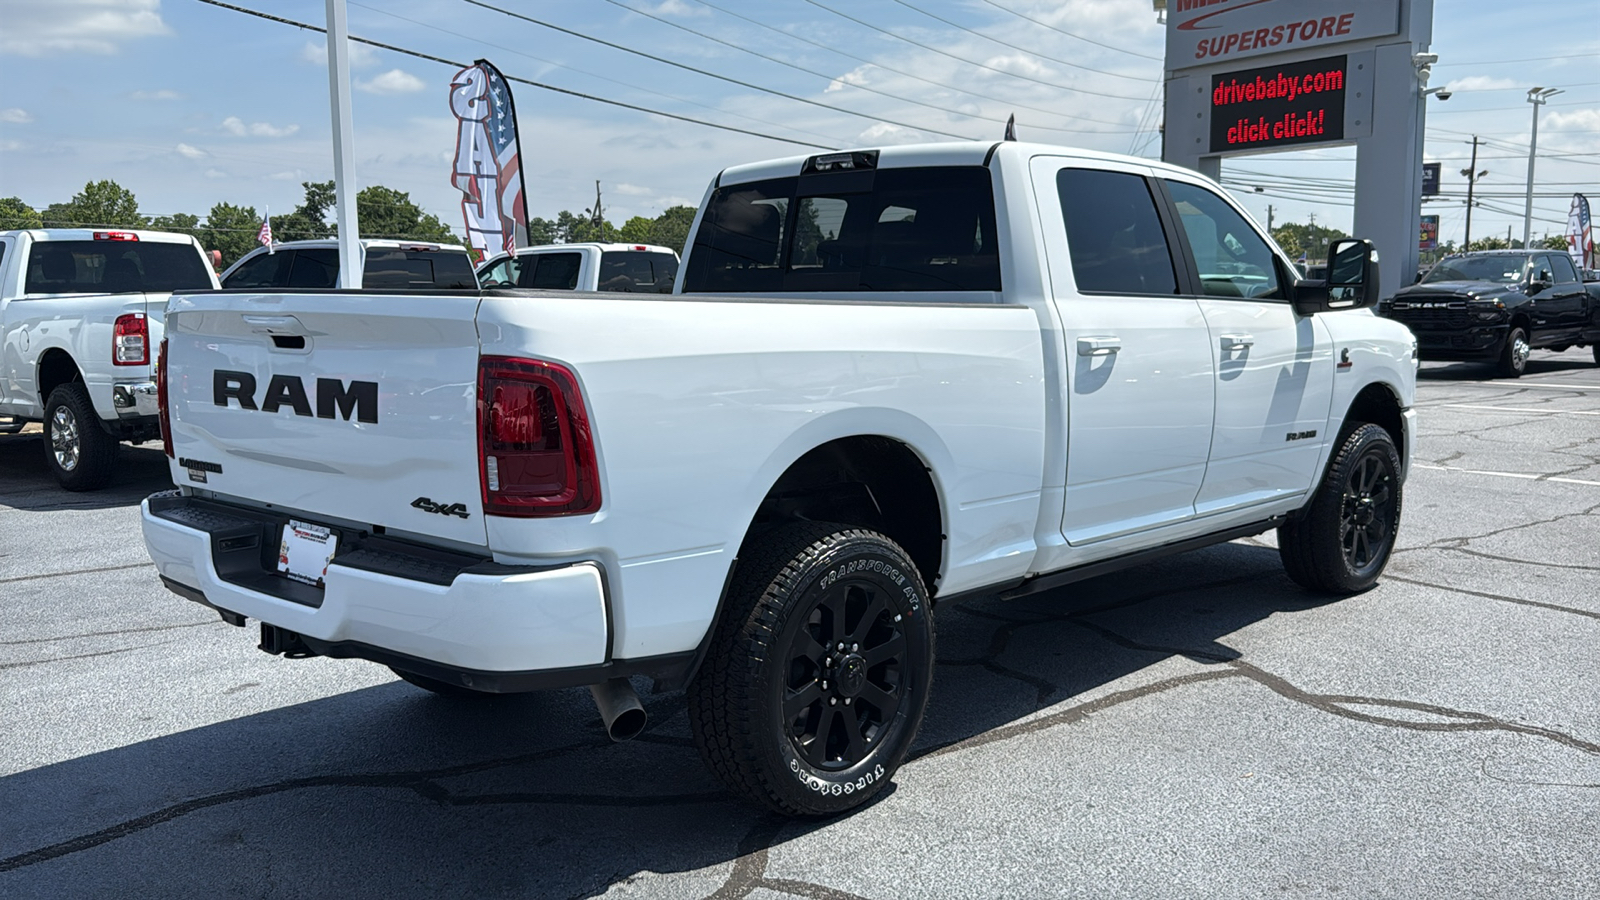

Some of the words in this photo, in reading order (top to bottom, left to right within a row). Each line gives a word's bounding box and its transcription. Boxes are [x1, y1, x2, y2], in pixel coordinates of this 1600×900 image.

[1195, 13, 1354, 59] SUPERSTORE
[1213, 70, 1343, 105] drivebaby.com
[1227, 116, 1270, 143] click
[1273, 109, 1324, 138] click!
[213, 369, 379, 424] RAM
[820, 559, 905, 590] TRANSFORCE
